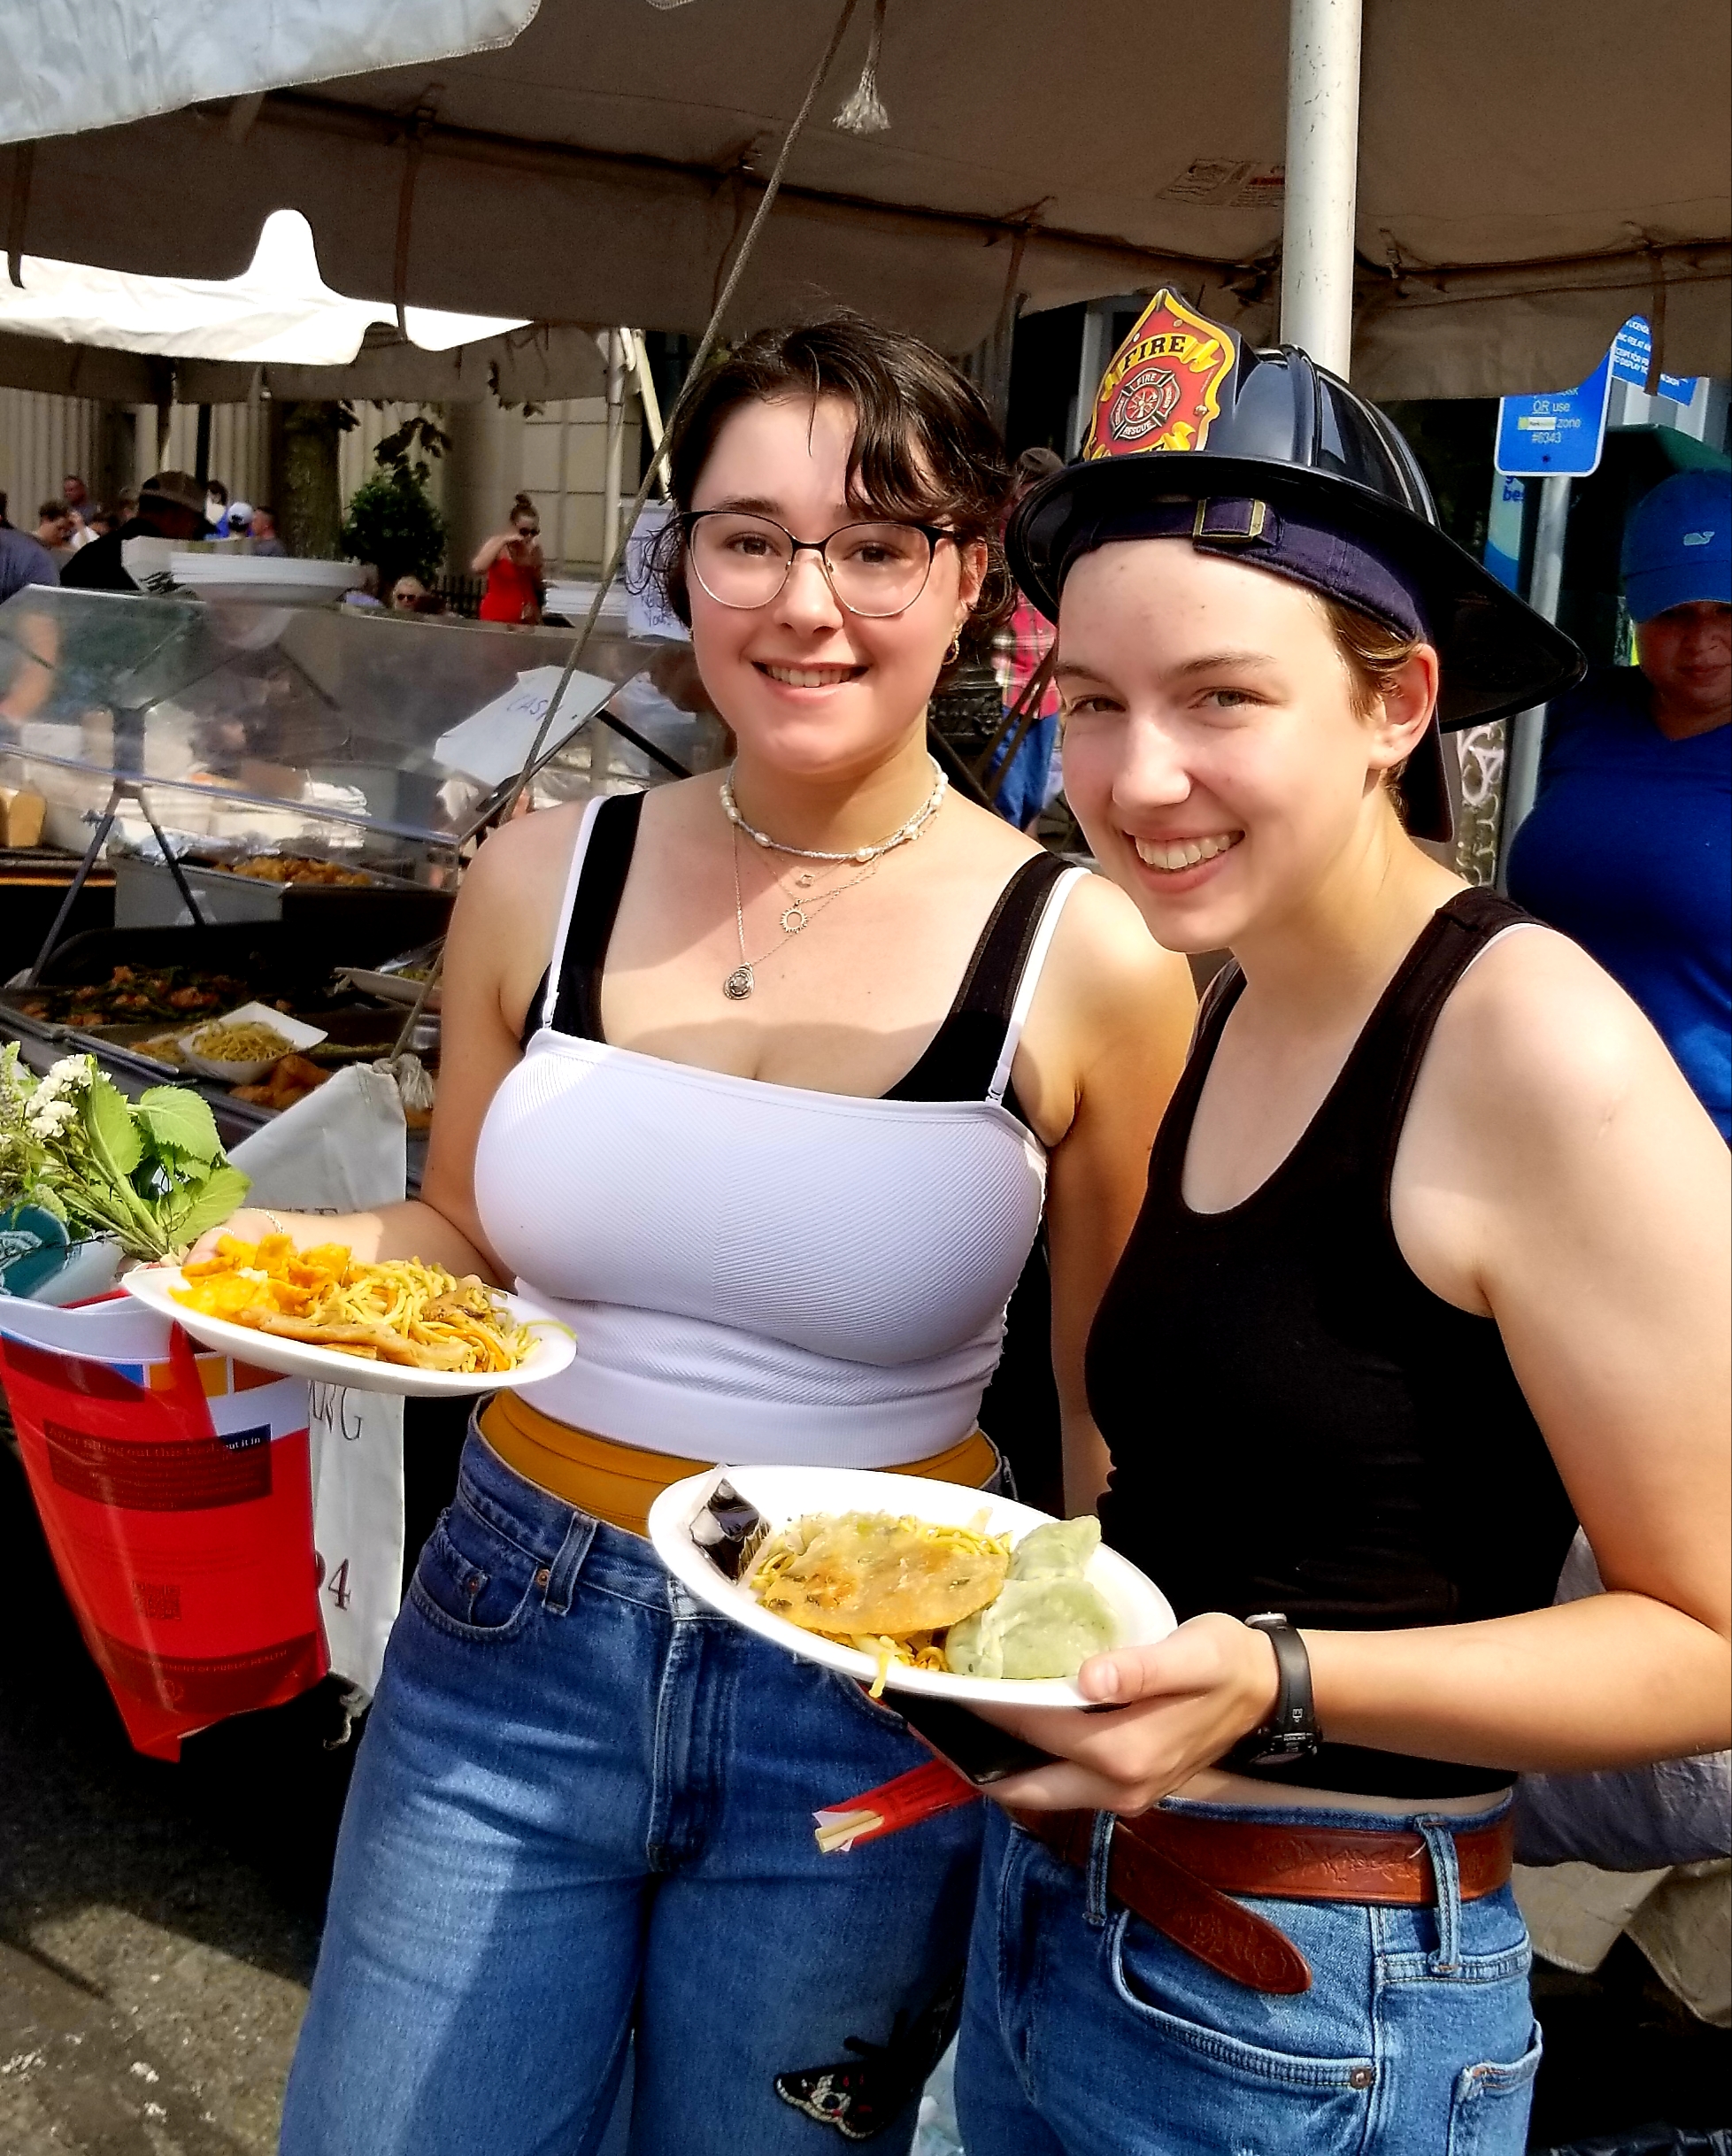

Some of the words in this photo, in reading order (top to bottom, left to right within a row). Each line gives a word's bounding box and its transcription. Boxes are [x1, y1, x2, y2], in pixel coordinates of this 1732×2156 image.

[1122, 335, 1187, 372] FIRE
[1136, 373, 1158, 386] FIRE
[1533, 399, 1551, 412] OR
[1552, 403, 1571, 412] use
[1122, 420, 1153, 435] RESCUE
[1557, 418, 1582, 429] zone
